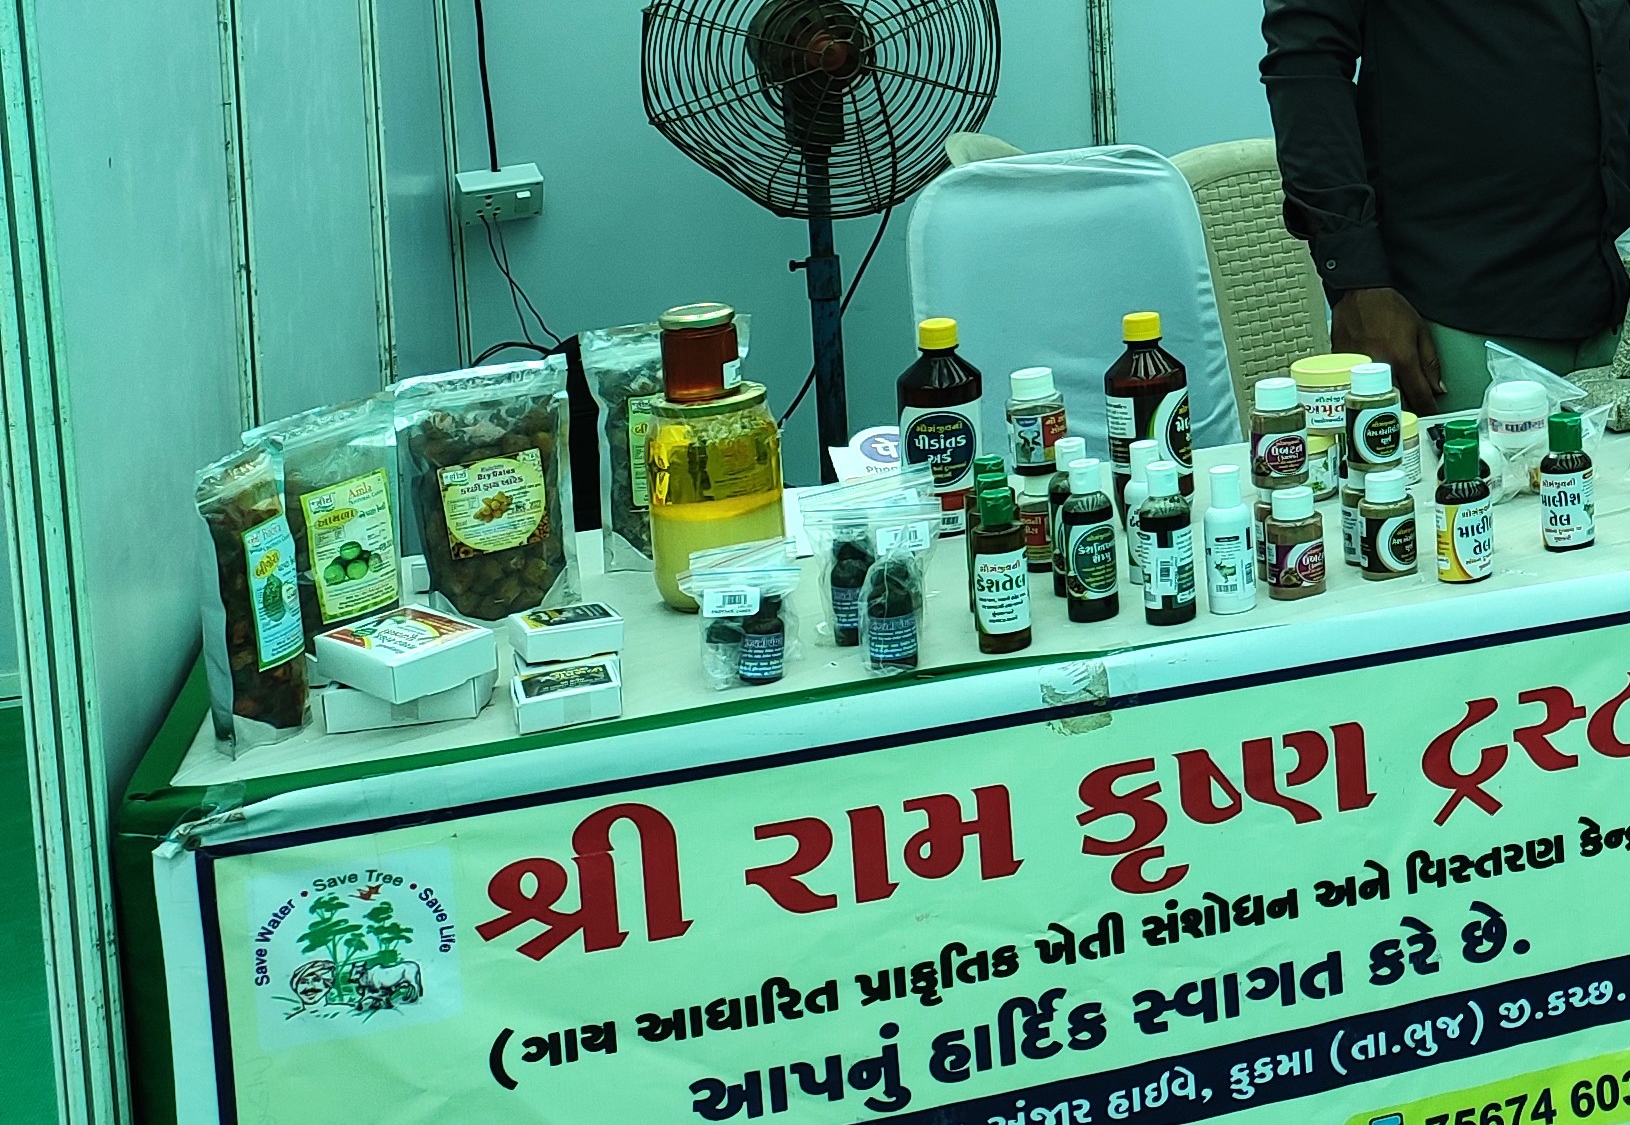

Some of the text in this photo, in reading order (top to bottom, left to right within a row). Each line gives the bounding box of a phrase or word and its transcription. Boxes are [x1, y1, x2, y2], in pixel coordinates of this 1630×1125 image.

[474, 801, 695, 962] શ્રી
[745, 783, 1026, 915] રામ
[1075, 720, 1378, 895] કૃષ્ણ
[312, 872, 359, 893] Save
[365, 869, 404, 887] Tree
[254, 898, 297, 944] Water
[418, 887, 448, 923] Save
[254, 947, 271, 987] Save
[488, 1020, 619, 1092] (ગાય
[636, 975, 840, 1044] આધારિત
[854, 941, 1020, 1007] પ્રાકૃતિક
[1034, 911, 1126, 967] ખેતી
[1141, 887, 1300, 948] સંશોધન
[1314, 859, 1391, 909] અને
[1406, 833, 1566, 895] વિસ્તરણ
[688, 900, 1532, 1123] આપનું હાર્દિક સ્વાગત કરે છે.
[1228, 1047, 1314, 1101] કુકમા
